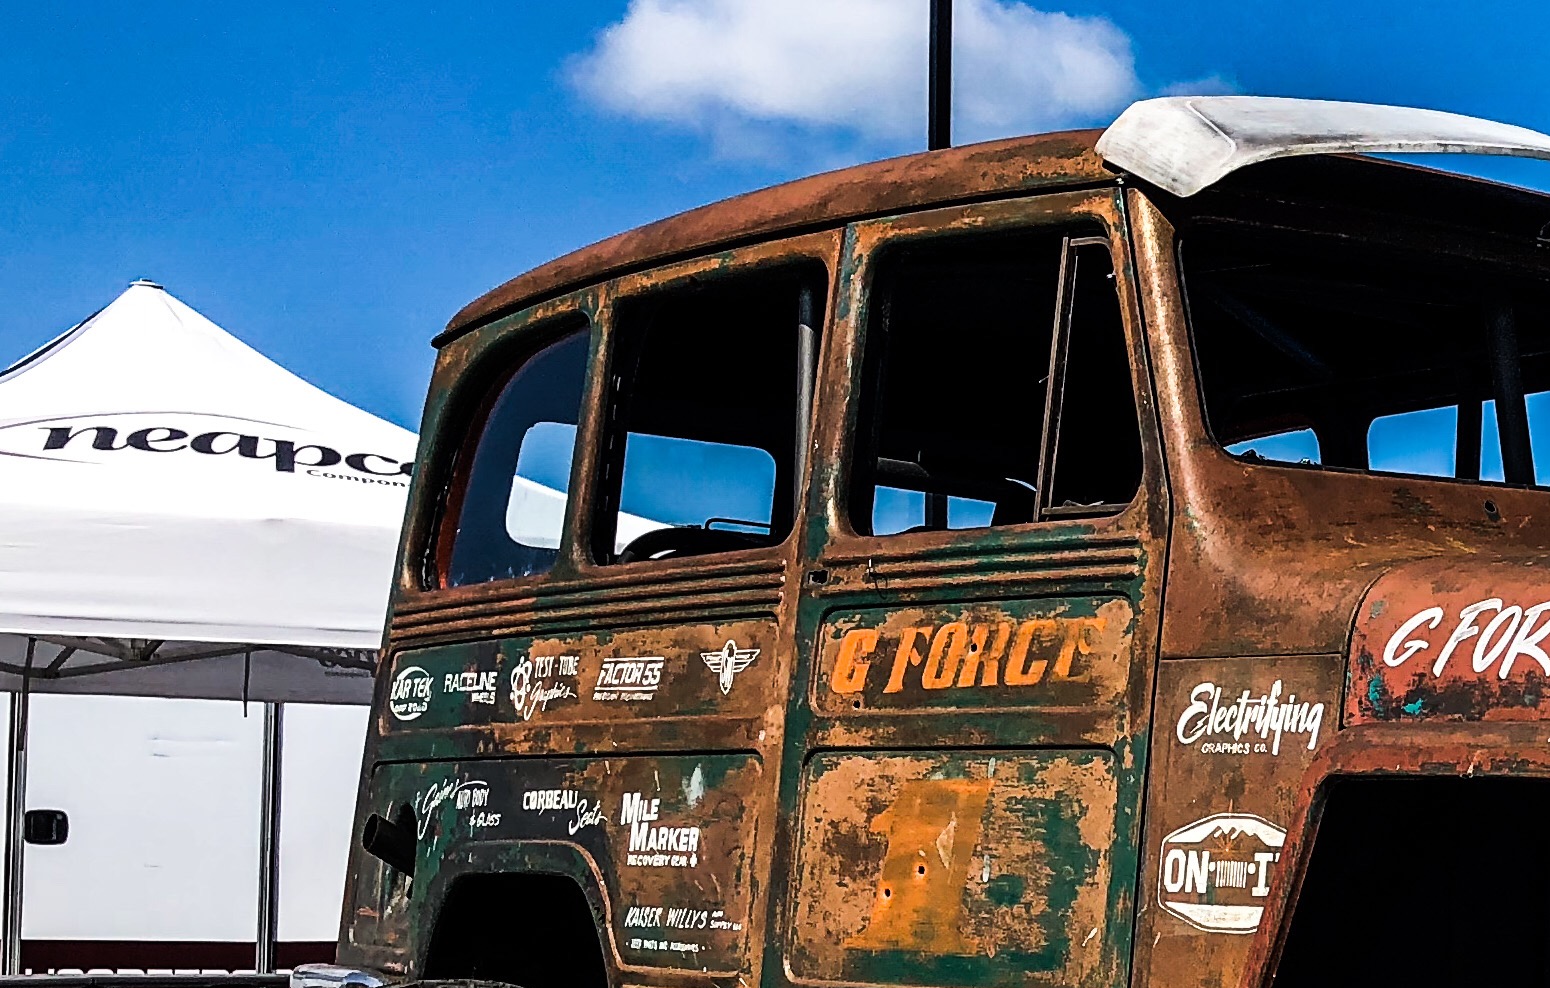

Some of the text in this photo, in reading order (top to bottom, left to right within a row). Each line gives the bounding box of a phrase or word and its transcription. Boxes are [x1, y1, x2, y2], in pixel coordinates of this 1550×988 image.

[38, 425, 414, 476] neapc
[306, 469, 410, 488] Compon
[1382, 606, 1443, 669] G
[830, 616, 1107, 694] G FORCE
[443, 671, 498, 693] RACELINE
[1176, 679, 1325, 756] Electrifying
[1201, 742, 1251, 755] GRAPHICS
[522, 789, 580, 815] CORBEAU
[620, 792, 660, 826] MILE
[629, 822, 700, 852] MARKER
[1163, 848, 1210, 894] ON
